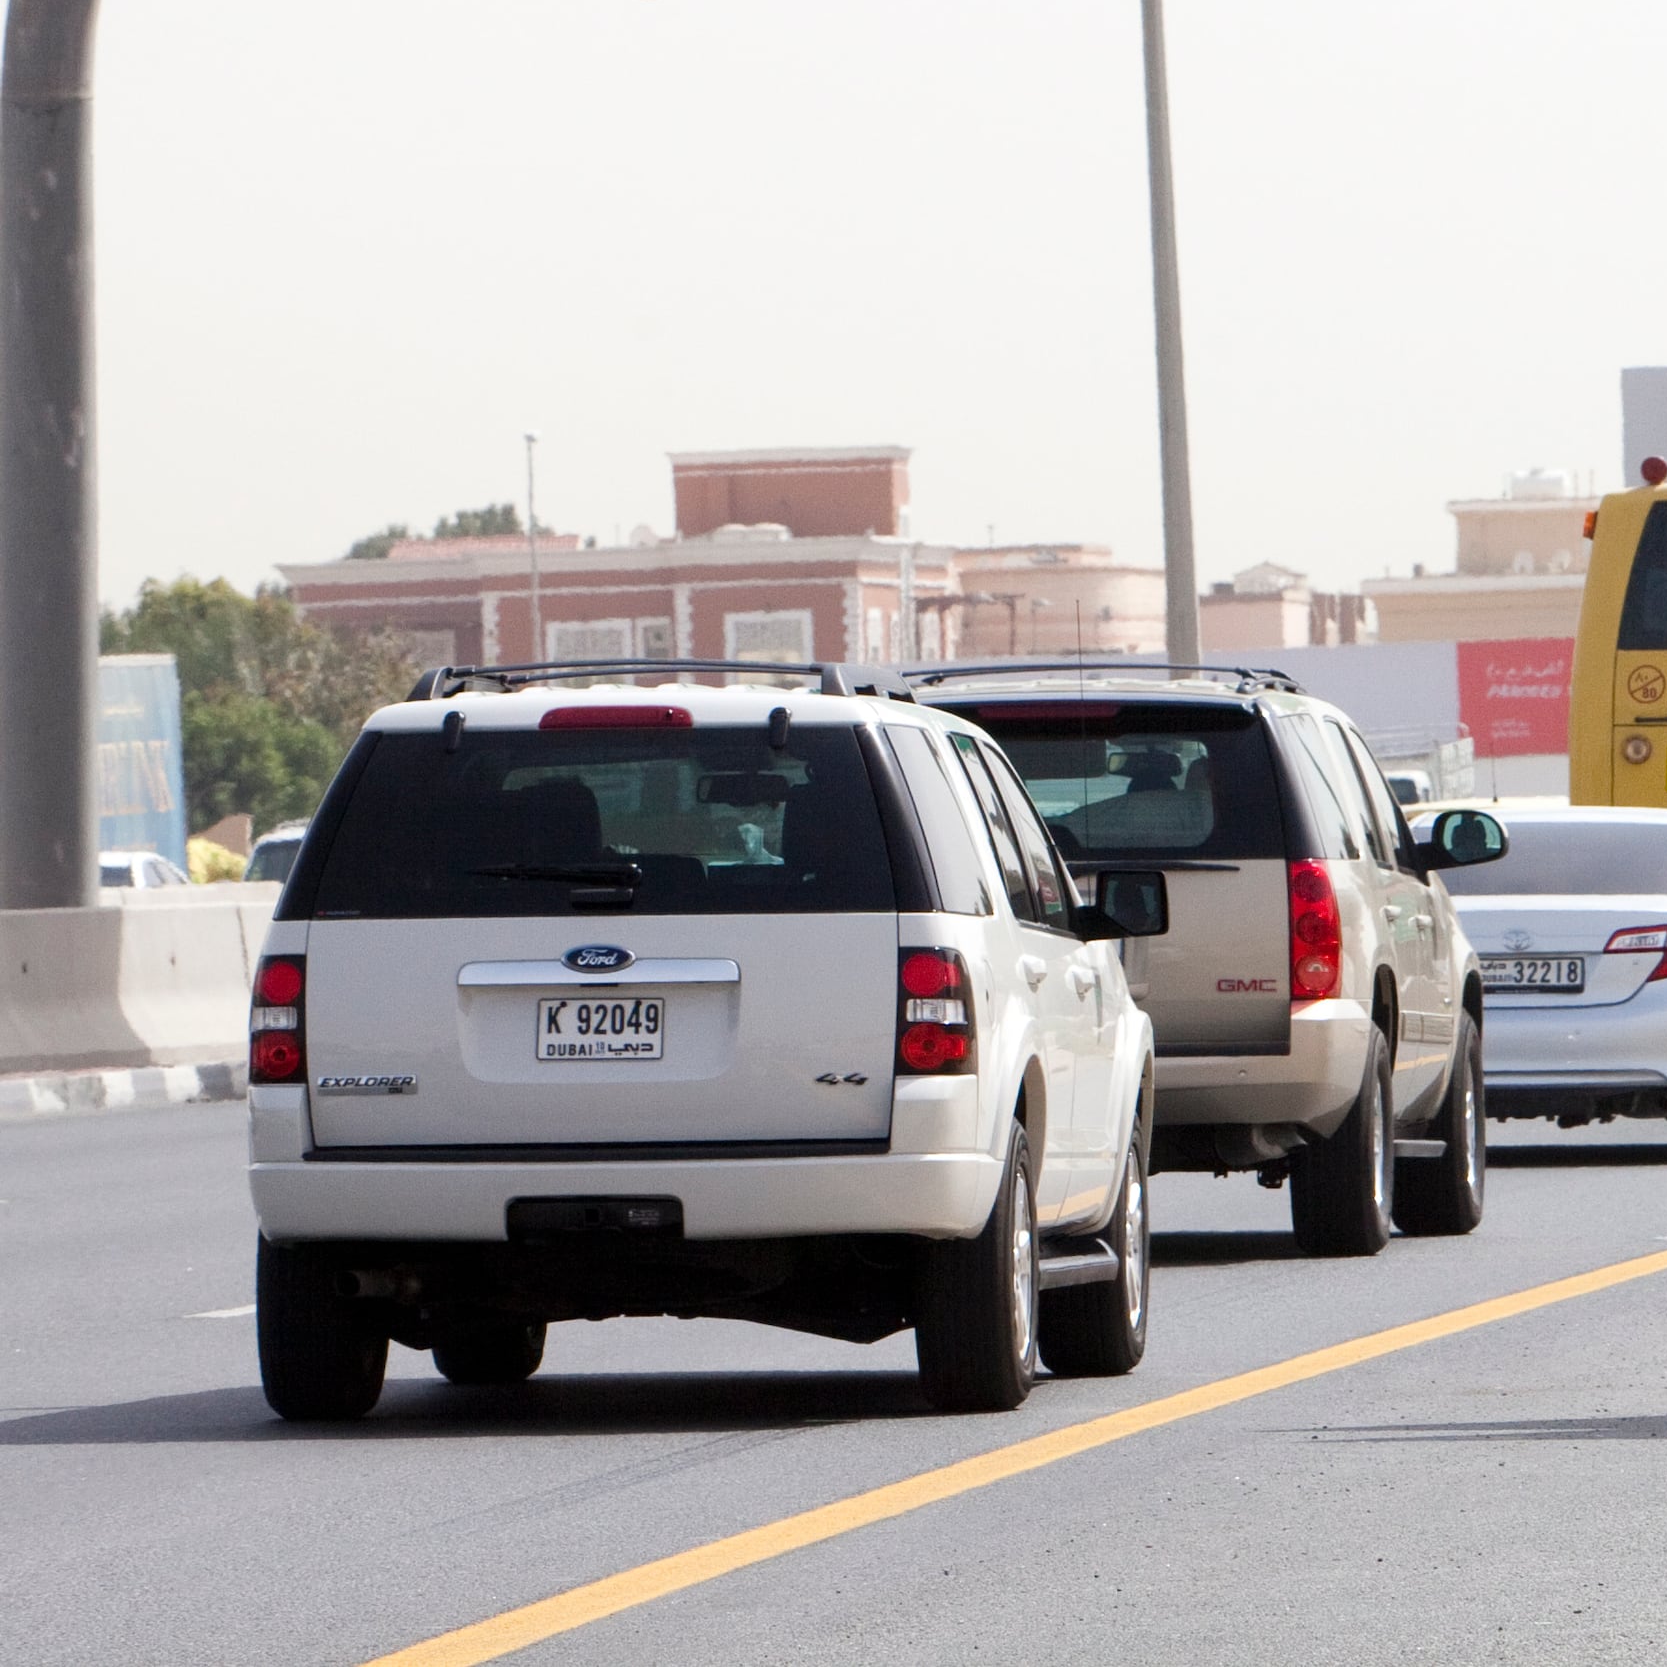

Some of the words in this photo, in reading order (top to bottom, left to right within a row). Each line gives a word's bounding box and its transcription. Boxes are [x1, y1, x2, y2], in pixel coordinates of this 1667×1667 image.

[576, 947, 618, 967] Ford
[1512, 959, 1579, 984] 32218
[1215, 978, 1277, 993] GMC
[546, 1005, 562, 1035] K
[576, 1003, 660, 1035] 92049
[545, 1044, 593, 1057] DUBAI
[319, 1076, 414, 1089] EXPLORER
